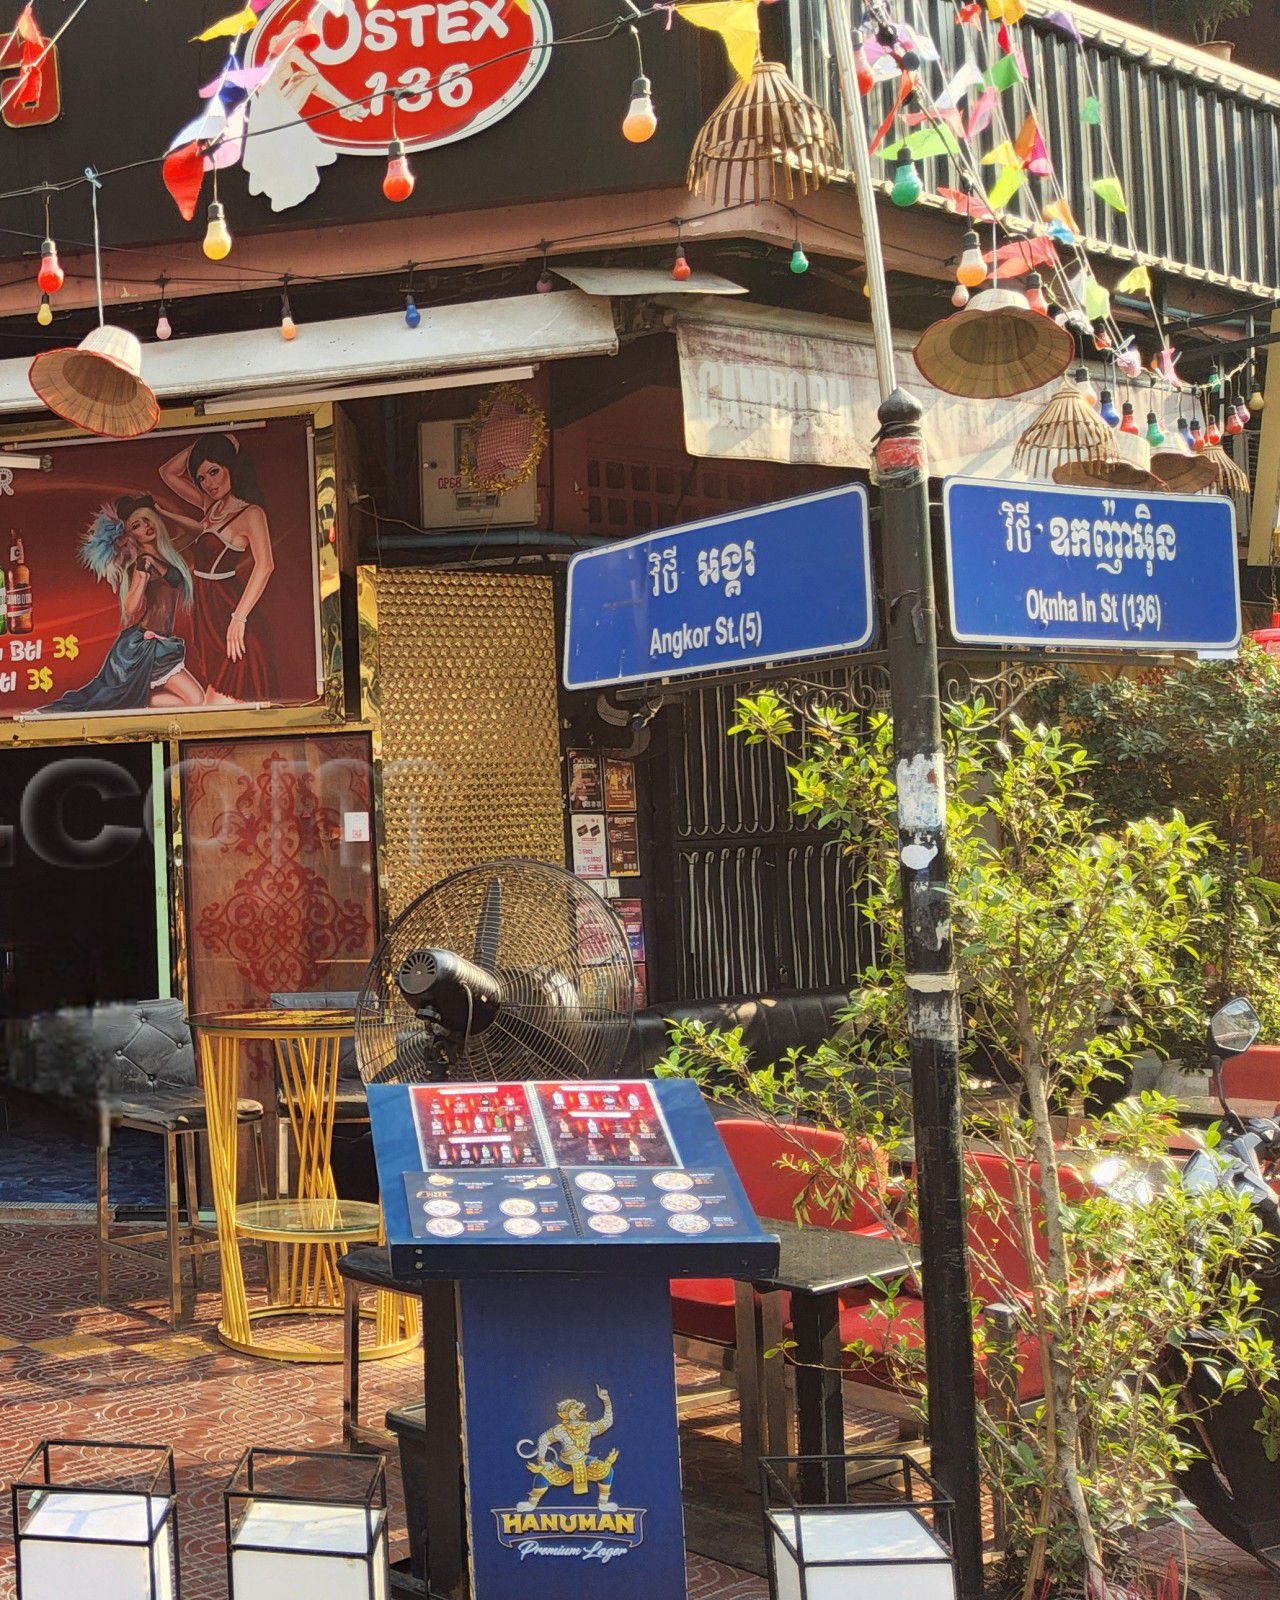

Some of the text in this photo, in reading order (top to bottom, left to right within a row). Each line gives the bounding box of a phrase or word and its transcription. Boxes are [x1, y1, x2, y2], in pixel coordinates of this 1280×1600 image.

[309, 0, 510, 65] OSTEX
[364, 62, 474, 116] 136
[1026, 587, 1162, 632] Oknha In St (136)
[9, 638, 43, 662] Btl
[52, 633, 80, 662] 3$
[649, 622, 711, 660] Angkor
[27, 665, 55, 694] 3$
[501, 1513, 637, 1535] HANUMAN
[517, 1540, 628, 1564] Premium Lager
